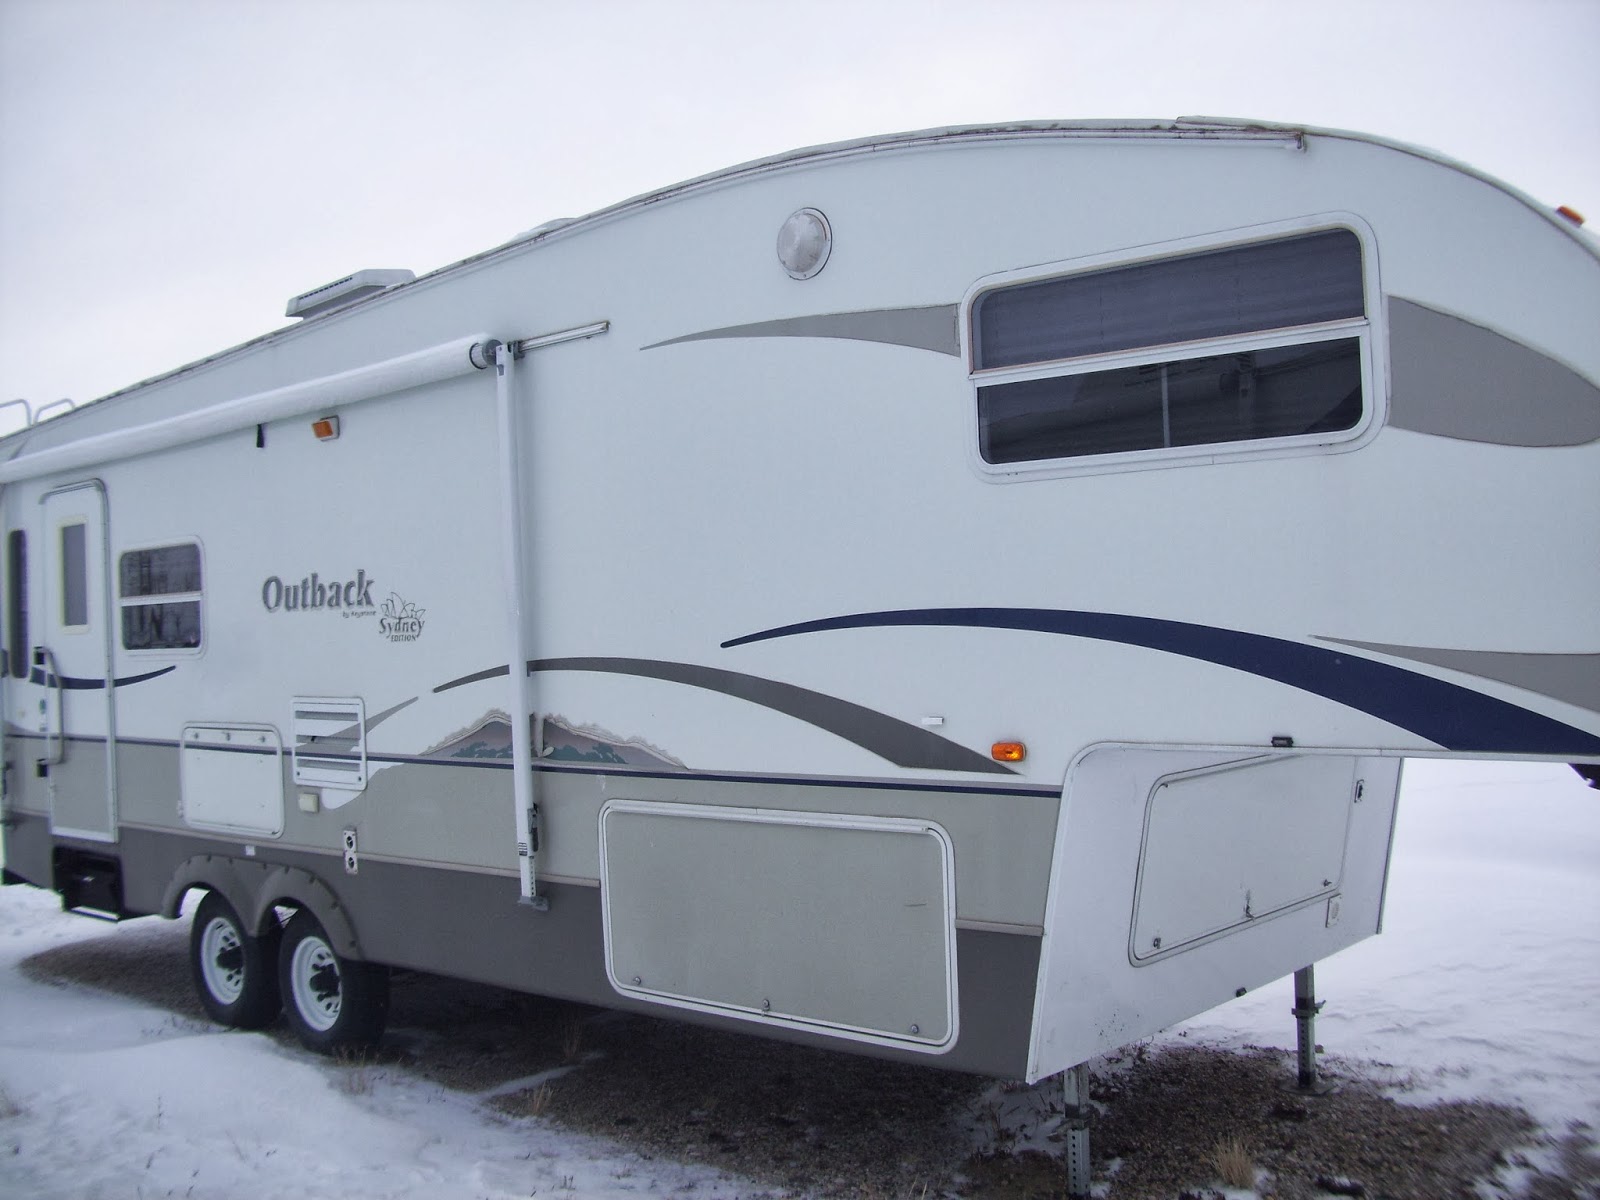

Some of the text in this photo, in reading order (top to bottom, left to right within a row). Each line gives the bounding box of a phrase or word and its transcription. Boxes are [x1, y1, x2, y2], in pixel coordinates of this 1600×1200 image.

[262, 569, 375, 612] Outback
[379, 617, 425, 638] Sydney
[391, 634, 416, 642] EDITION
